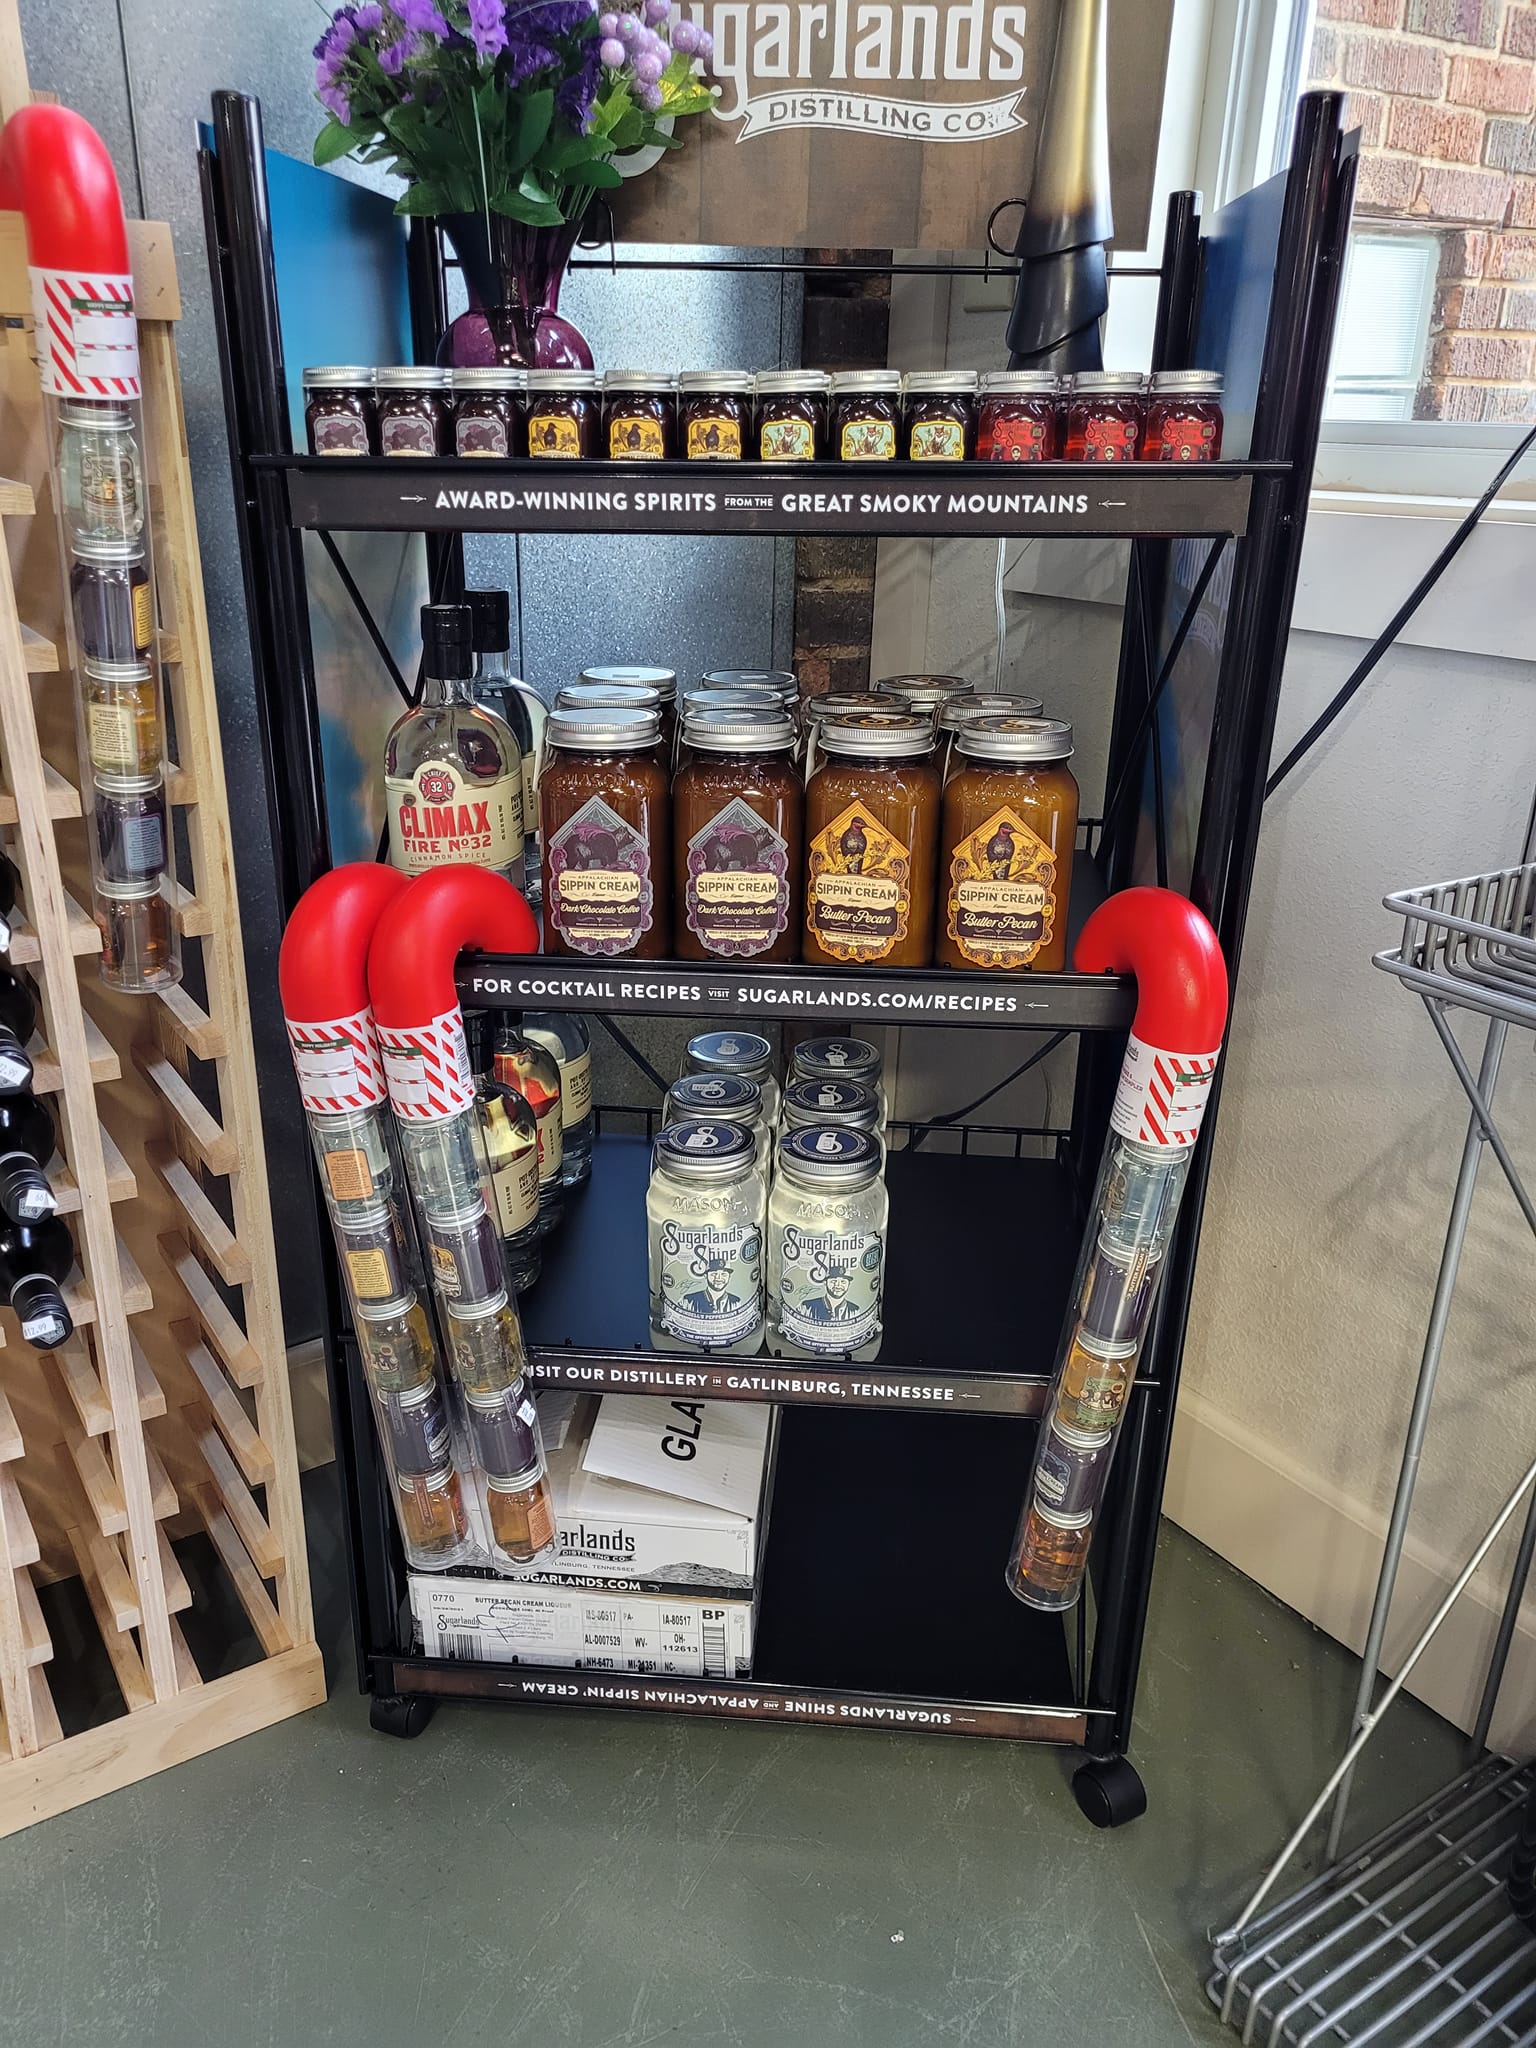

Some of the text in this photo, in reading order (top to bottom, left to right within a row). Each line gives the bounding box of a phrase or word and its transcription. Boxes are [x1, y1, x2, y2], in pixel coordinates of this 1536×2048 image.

[768, 98, 931, 132] DISTILLING
[435, 490, 1088, 514] AWARD-WINNING SPIRITS FROM THE GREAT SMOKY MOUNTAINS
[430, 781, 443, 793] 32
[398, 800, 492, 839] CLIMAX
[403, 839, 441, 854] FIRE
[410, 853, 453, 863] CINNAMON
[599, 881, 640, 892] CREAM
[738, 882, 777, 894] CREAM
[855, 887, 898, 901] CREAM
[1001, 893, 1044, 905] CREAM
[560, 902, 640, 914] Dark Chocolate Coffee
[697, 904, 717, 914] Dark
[718, 905, 755, 915] Chocolate
[818, 904, 893, 924] Butter Pecan
[961, 911, 1038, 929] Butter Pecan
[473, 977, 1018, 1012] FOR COCKTAIL RECIPES VISIT SUGARLANDS.COM/RECIPES
[662, 1221, 744, 1255] Sugarlands
[783, 1225, 865, 1261] Sugarlands
[690, 1245, 738, 1277] Shine
[810, 1250, 858, 1283] Shine
[1127, 1252, 1146, 1292] BUTTER PECAN
[566, 1367, 604, 1381] OUR
[610, 1369, 708, 1387] DISTILLERY
[726, 1376, 847, 1398] GATLINBURG,
[851, 1383, 954, 1401] TENNESSEE
[562, 1550, 610, 1561] DISTILLING
[592, 1564, 636, 1572] TENNESSEE
[513, 1572, 641, 1591] SUGARLANDS.COM
[432, 1594, 455, 1603] 0770
[474, 1596, 499, 1604] BUTTER
[500, 1598, 521, 1606] PECAN
[522, 1599, 544, 1607] CREAM
[437, 1614, 480, 1631] Sugarlands
[662, 1614, 691, 1626] IA-80517
[702, 1609, 725, 1620] BP
[584, 1633, 621, 1647] AL-D007529
[662, 1645, 698, 1653] 112613
[521, 1681, 951, 1725] SUGARLANDS SHINE AND APPALACHIAN SIPPIN' CREAM
